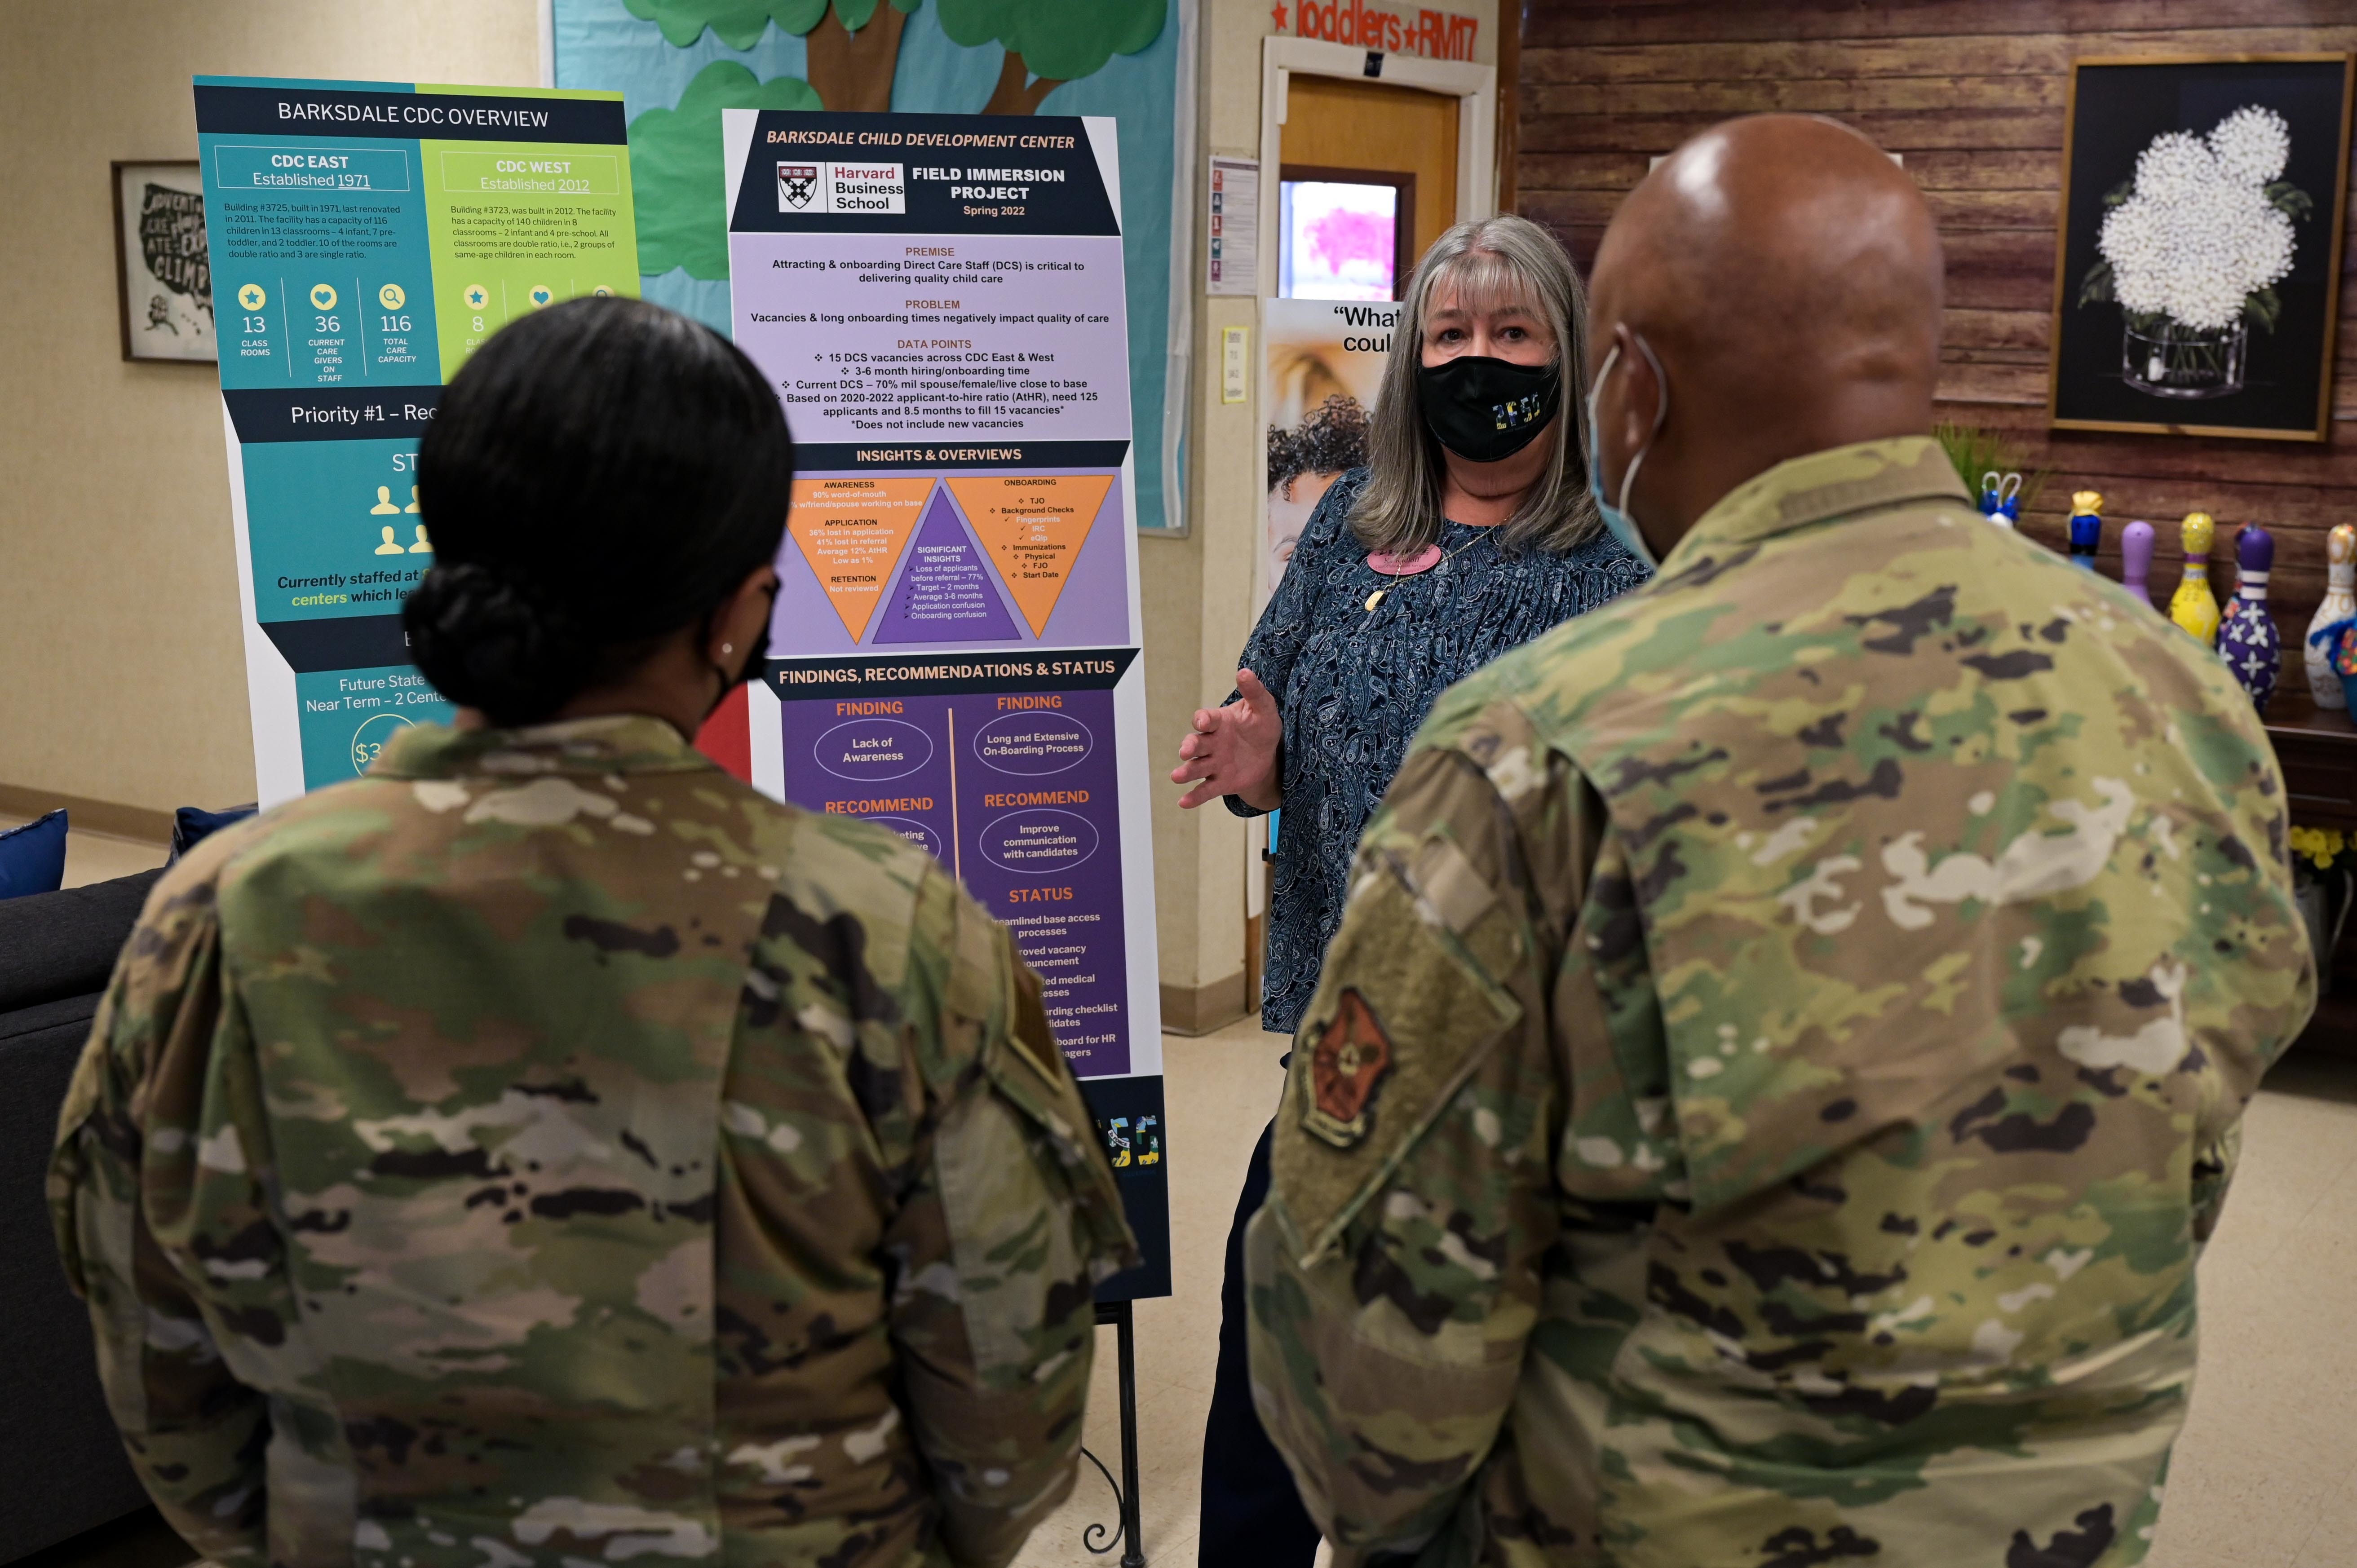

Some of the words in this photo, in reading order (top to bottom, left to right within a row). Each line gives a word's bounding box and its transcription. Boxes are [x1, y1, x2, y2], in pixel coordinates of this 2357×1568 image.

[279, 102, 399, 122] BARKSDALE
[403, 107, 444, 124] CDC
[448, 108, 548, 127] OVERVIEW
[767, 131, 855, 145] BARKSDALE
[858, 133, 902, 145] CHILD
[906, 133, 1017, 147] DEVELOPMENT
[1020, 136, 1075, 148] CENTER
[271, 155, 305, 168] CDC
[308, 155, 349, 168] EAST
[496, 160, 526, 173] CDC
[529, 161, 571, 174] WEST
[835, 167, 895, 179] Harvard
[912, 168, 961, 180] FIELD
[967, 168, 1065, 182] IMMERSION
[253, 172, 335, 186] Established
[338, 174, 371, 187] 1971
[481, 177, 555, 190] Established
[558, 179, 591, 191] 2012
[836, 182, 903, 194] Business
[951, 186, 1030, 199] PROJECT
[224, 203, 259, 213] Building
[261, 203, 290, 212] #3725,
[291, 204, 310, 212] built
[320, 204, 341, 213] 1971,
[836, 197, 889, 209] School
[964, 205, 998, 217] Spring
[1001, 206, 1025, 215] 2022
[906, 247, 955, 256] PREMISE
[772, 260, 825, 271] Attracting
[828, 260, 836, 269] &
[840, 260, 901, 271] onboarding
[904, 261, 935, 269] Direct
[938, 261, 962, 269] Care
[965, 261, 990, 270] Staff
[992, 261, 1022, 272] (DCS)
[1025, 261, 1034, 270] is
[1037, 261, 1071, 270] critical
[1074, 262, 1084, 270] to
[859, 274, 911, 285] delivering
[914, 274, 949, 285] quality
[952, 274, 977, 283] child
[906, 300, 960, 309] PROBLEM
[243, 316, 265, 333] 13
[315, 316, 340, 332] 36
[380, 315, 411, 331] 116
[472, 316, 484, 332] 8
[898, 340, 928, 349] DATA
[931, 340, 972, 349] POINTS
[1344, 333, 1390, 352] coul
[829, 353, 841, 362] 15
[845, 353, 867, 362] DCS
[871, 353, 924, 362] vacancies
[965, 353, 988, 362] CDC
[992, 353, 1015, 362] East
[1018, 353, 1025, 362] &
[1028, 353, 1054, 362] West
[855, 367, 871, 375] 3-6
[875, 367, 908, 375] month
[911, 366, 1004, 377] hiring/onboarding
[1008, 366, 1030, 375] time
[292, 406, 359, 425] Priority
[364, 405, 385, 421] #1
[857, 450, 922, 461] INSIGHTS
[925, 450, 936, 461] &
[939, 449, 1022, 460] OVERVIEWS
[1001, 507, 1045, 515] Background
[1016, 516, 1061, 524] Fingerprints
[1030, 534, 1048, 543] eQip
[817, 548, 848, 556] Average
[1025, 553, 1055, 561] Physical
[278, 574, 346, 589] Currently
[349, 570, 401, 584] staffed
[404, 570, 419, 581] at
[916, 584, 939, 592] Target
[292, 593, 348, 606] centers
[351, 588, 392, 602] which
[779, 668, 862, 684] FINDINGS,
[865, 663, 1033, 681] RECOMMENDATIONS
[1036, 663, 1049, 676] &
[1052, 660, 1115, 675] STATUS
[340, 678, 385, 692] Future
[389, 675, 425, 688] State
[306, 700, 340, 712] Near
[343, 697, 380, 709] Term
[395, 693, 403, 705] 2
[836, 701, 903, 716] FINDING
[997, 695, 1062, 710] FINDING
[853, 738, 879, 748] Lack
[881, 737, 893, 747] of
[987, 735, 1011, 745] Long
[1014, 733, 1031, 742] and
[1034, 732, 1079, 742] Extensive
[983, 745, 1044, 755] On-Boarding
[1046, 744, 1084, 753] Process
[843, 752, 903, 762] Awareness
[985, 790, 1089, 807] RECOMMEND
[826, 797, 934, 813] RECOMMEND
[1020, 825, 1059, 835] Improve
[1004, 835, 1076, 847] communication
[1003, 849, 1024, 859] with
[1026, 848, 1078, 858] candidates
[1009, 887, 1073, 903] STATUS
[1044, 915, 1066, 924] base
[1068, 914, 1100, 923] access
[1018, 928, 1067, 938] processes
[1048, 945, 1086, 954] vacancy
[1058, 974, 1095, 985] medical
[1075, 1003, 1118, 1014] checklist
[1085, 1035, 1100, 1044] for
[1101, 1034, 1116, 1043] HR
